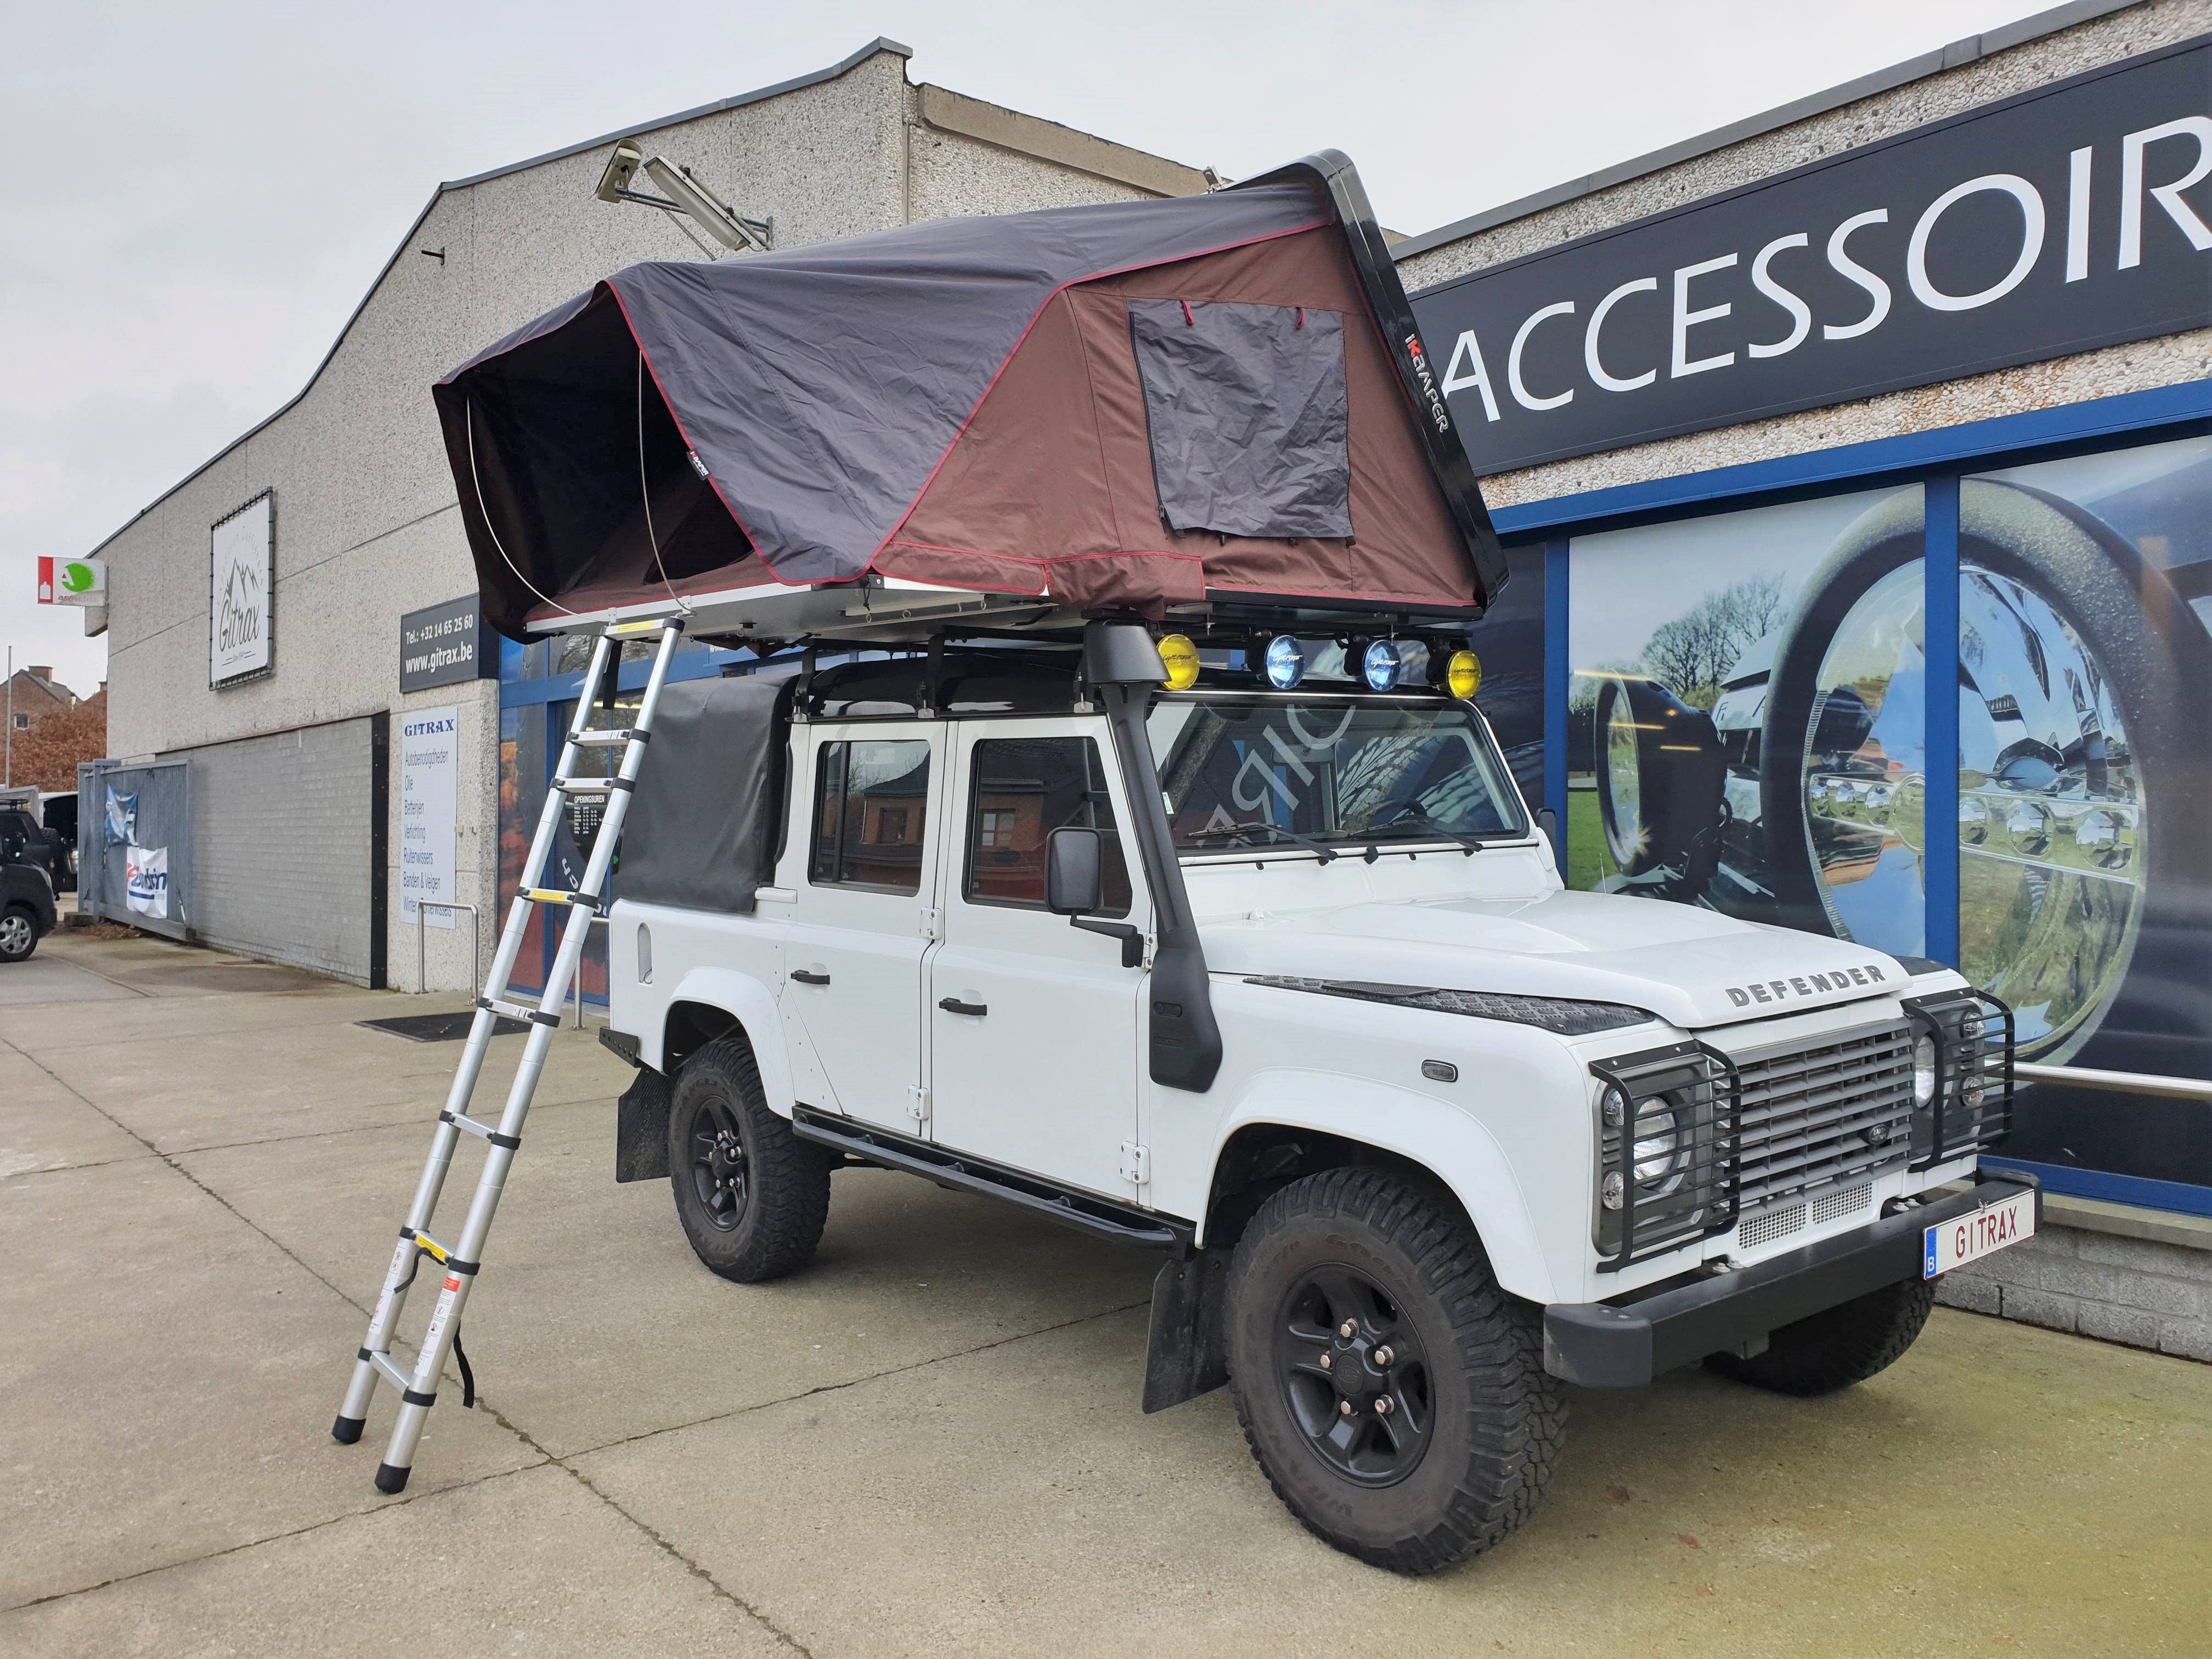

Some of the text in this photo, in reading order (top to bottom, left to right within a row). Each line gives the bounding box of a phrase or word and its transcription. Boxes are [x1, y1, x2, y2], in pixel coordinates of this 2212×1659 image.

[1441, 115, 2212, 422] ACCESSOIR
[219, 599, 260, 652] Gitrax
[406, 614, 473, 645] Tel.: +32 14 65 25 60
[406, 641, 472, 673] www.gitrax.be
[404, 719, 454, 737] GITRAX
[405, 775, 414, 791] Olie
[404, 799, 425, 819] Batterijen
[574, 795, 605, 804] OPENINGSUREN
[404, 823, 426, 844] Verlichting
[403, 871, 441, 894] Banden & Velgen
[403, 895, 417, 912] Winter
[1725, 964, 1886, 1007] DEFENDER
[1955, 1205, 2017, 1259] GITRAX
[1927, 1256, 1934, 1272] B
